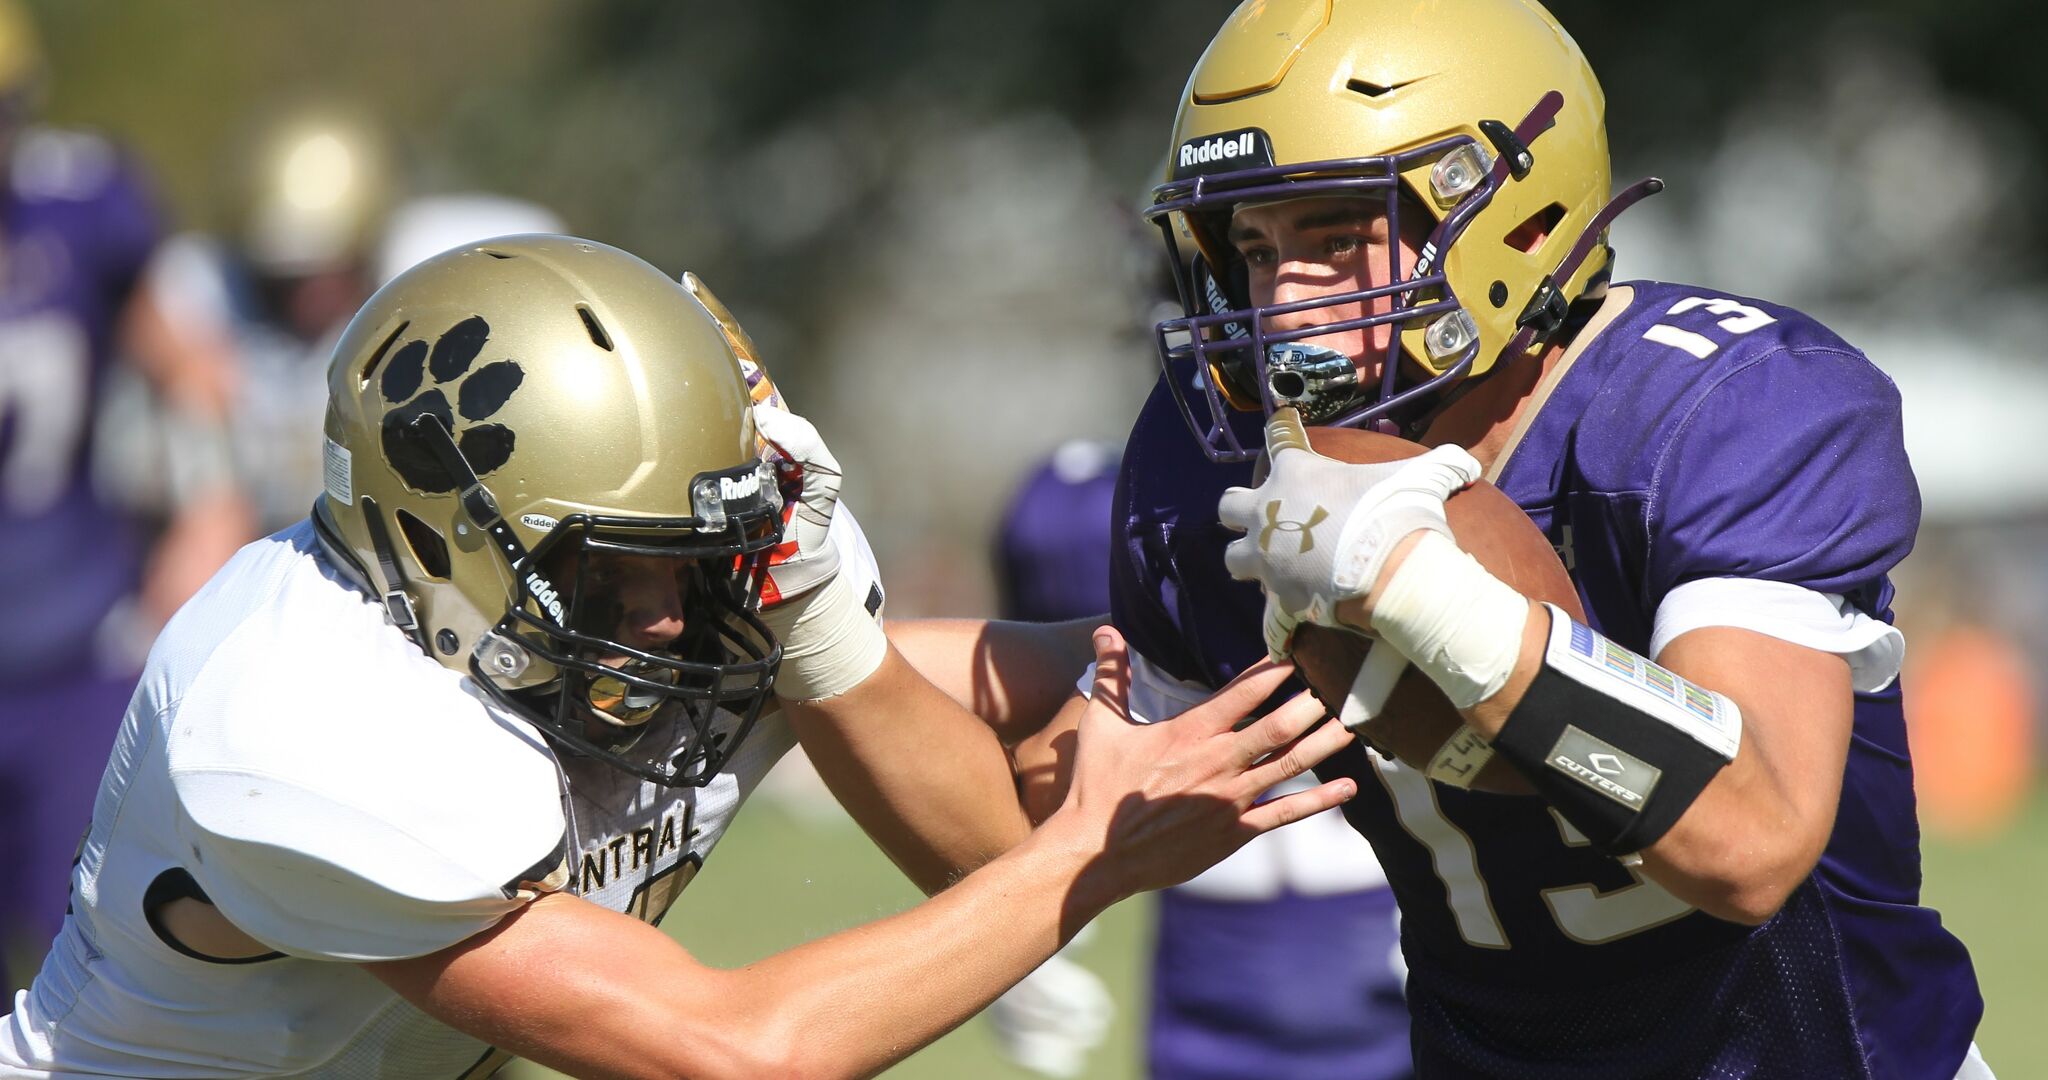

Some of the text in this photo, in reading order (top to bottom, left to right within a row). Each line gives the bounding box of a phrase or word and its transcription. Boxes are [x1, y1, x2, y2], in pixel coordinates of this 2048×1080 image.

[1180, 132, 1254, 167] Riddell
[1642, 296, 1778, 359] 13
[1555, 755, 1643, 801] CUTTERS
[578, 805, 700, 896] NTRAL
